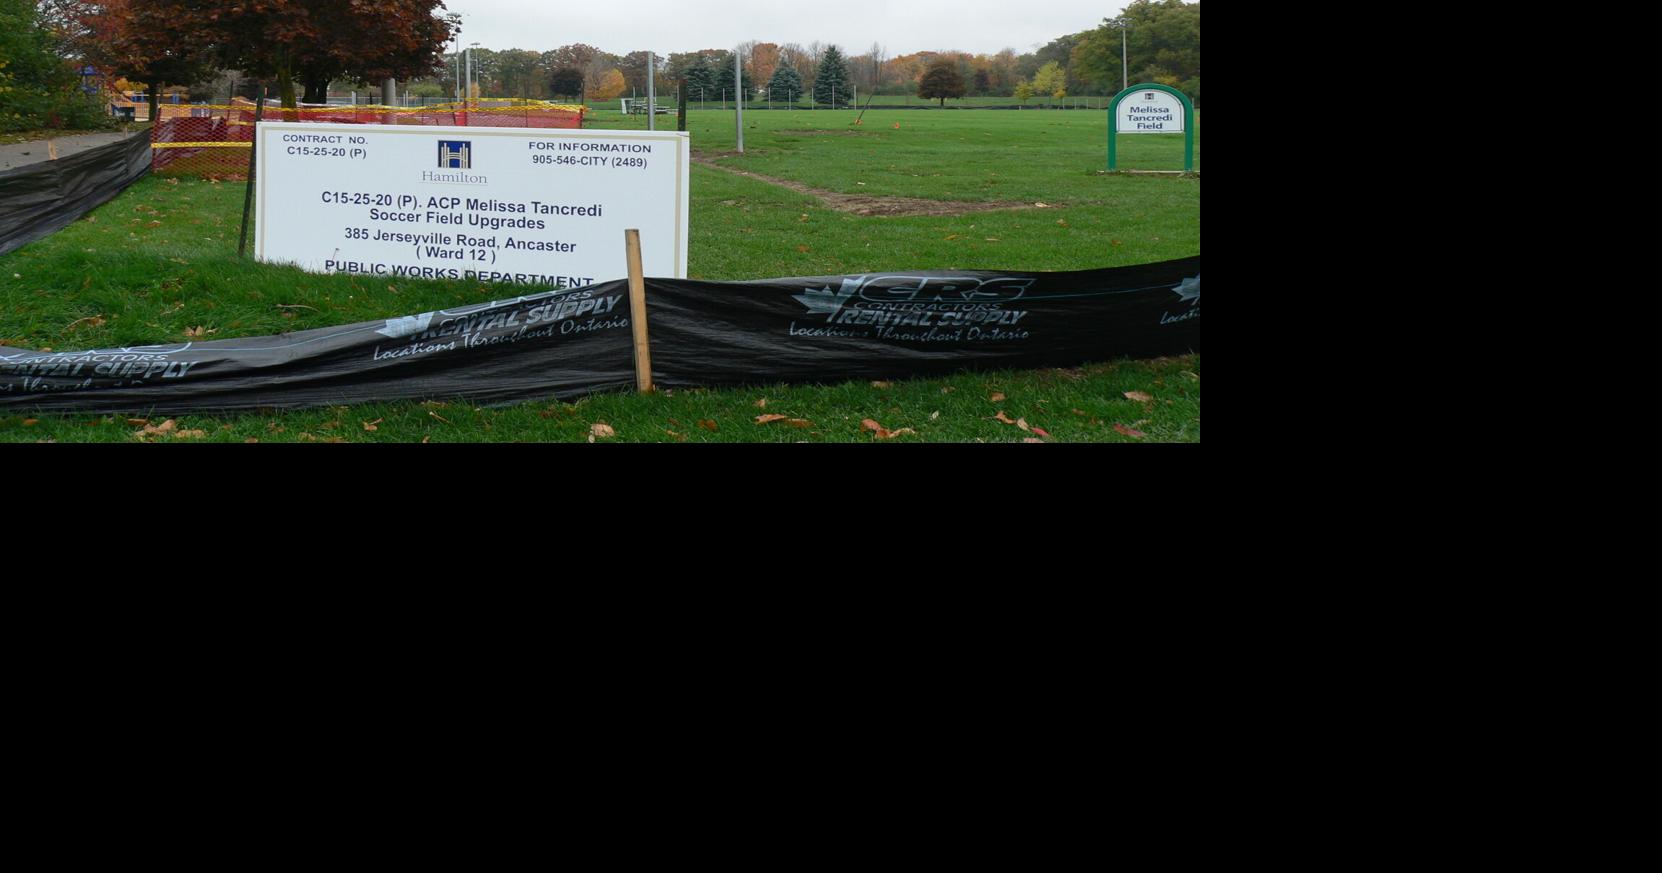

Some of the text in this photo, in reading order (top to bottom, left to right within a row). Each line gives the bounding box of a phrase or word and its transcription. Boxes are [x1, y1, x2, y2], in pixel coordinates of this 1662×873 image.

[1129, 106, 1170, 114] Melissa
[1127, 114, 1173, 122] Tancredi
[1136, 122, 1163, 130] Field
[282, 134, 369, 145] CONTRACT NO.
[287, 146, 367, 159] C15-25-20 (P)
[528, 141, 652, 153] FOR INFORMATION
[532, 154, 648, 169] 905-546-CITY (2489)
[421, 171, 488, 185] Hamilton
[321, 191, 603, 217] C15-25-20 (P). ACP Melissa Tancredi
[369, 208, 545, 230] Soccer Field Upgrades
[344, 227, 577, 253] 385 Jerseyville Road, Ancaster
[425, 246, 464, 260] Ward
[469, 249, 486, 262] 12
[325, 259, 386, 275] PUBLIC
[392, 264, 459, 280] WORKS
[525, 294, 624, 325] SUPPLY
[853, 301, 1002, 312] CONTRACTORS
[835, 309, 1028, 327] RENTAL SUPPLY
[373, 340, 458, 361] Locations
[560, 317, 630, 336] Ontario
[965, 327, 1030, 341] Ontario
